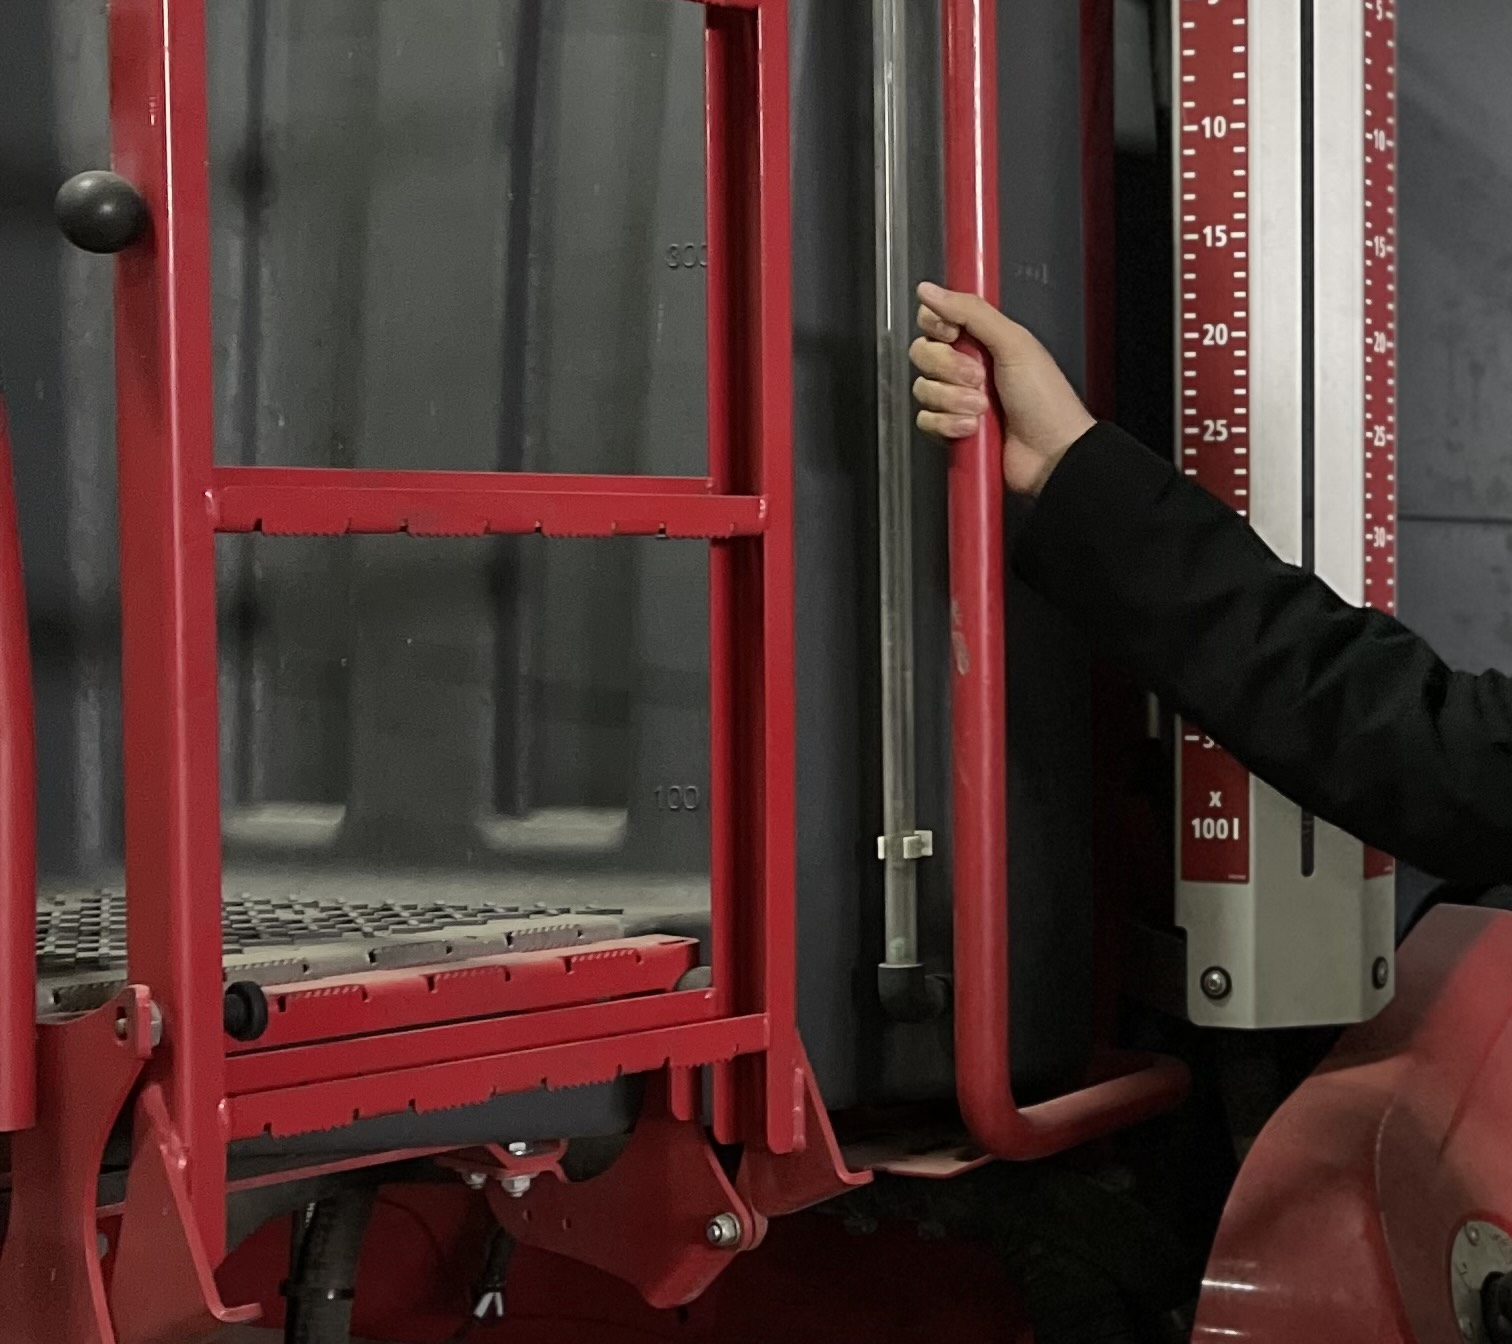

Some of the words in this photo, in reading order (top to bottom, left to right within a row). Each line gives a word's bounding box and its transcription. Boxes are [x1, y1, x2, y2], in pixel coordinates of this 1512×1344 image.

[1201, 115, 1227, 139] 10
[1373, 128, 1386, 152] 10
[1202, 224, 1228, 248] 15
[1373, 235, 1387, 259] 15
[1202, 323, 1229, 346] 20
[1373, 330, 1387, 354] 20
[1203, 419, 1229, 442] 25
[1373, 424, 1387, 447] 25
[1373, 525, 1387, 548] 30
[1208, 791, 1222, 808] x
[1191, 817, 1229, 840] 100
